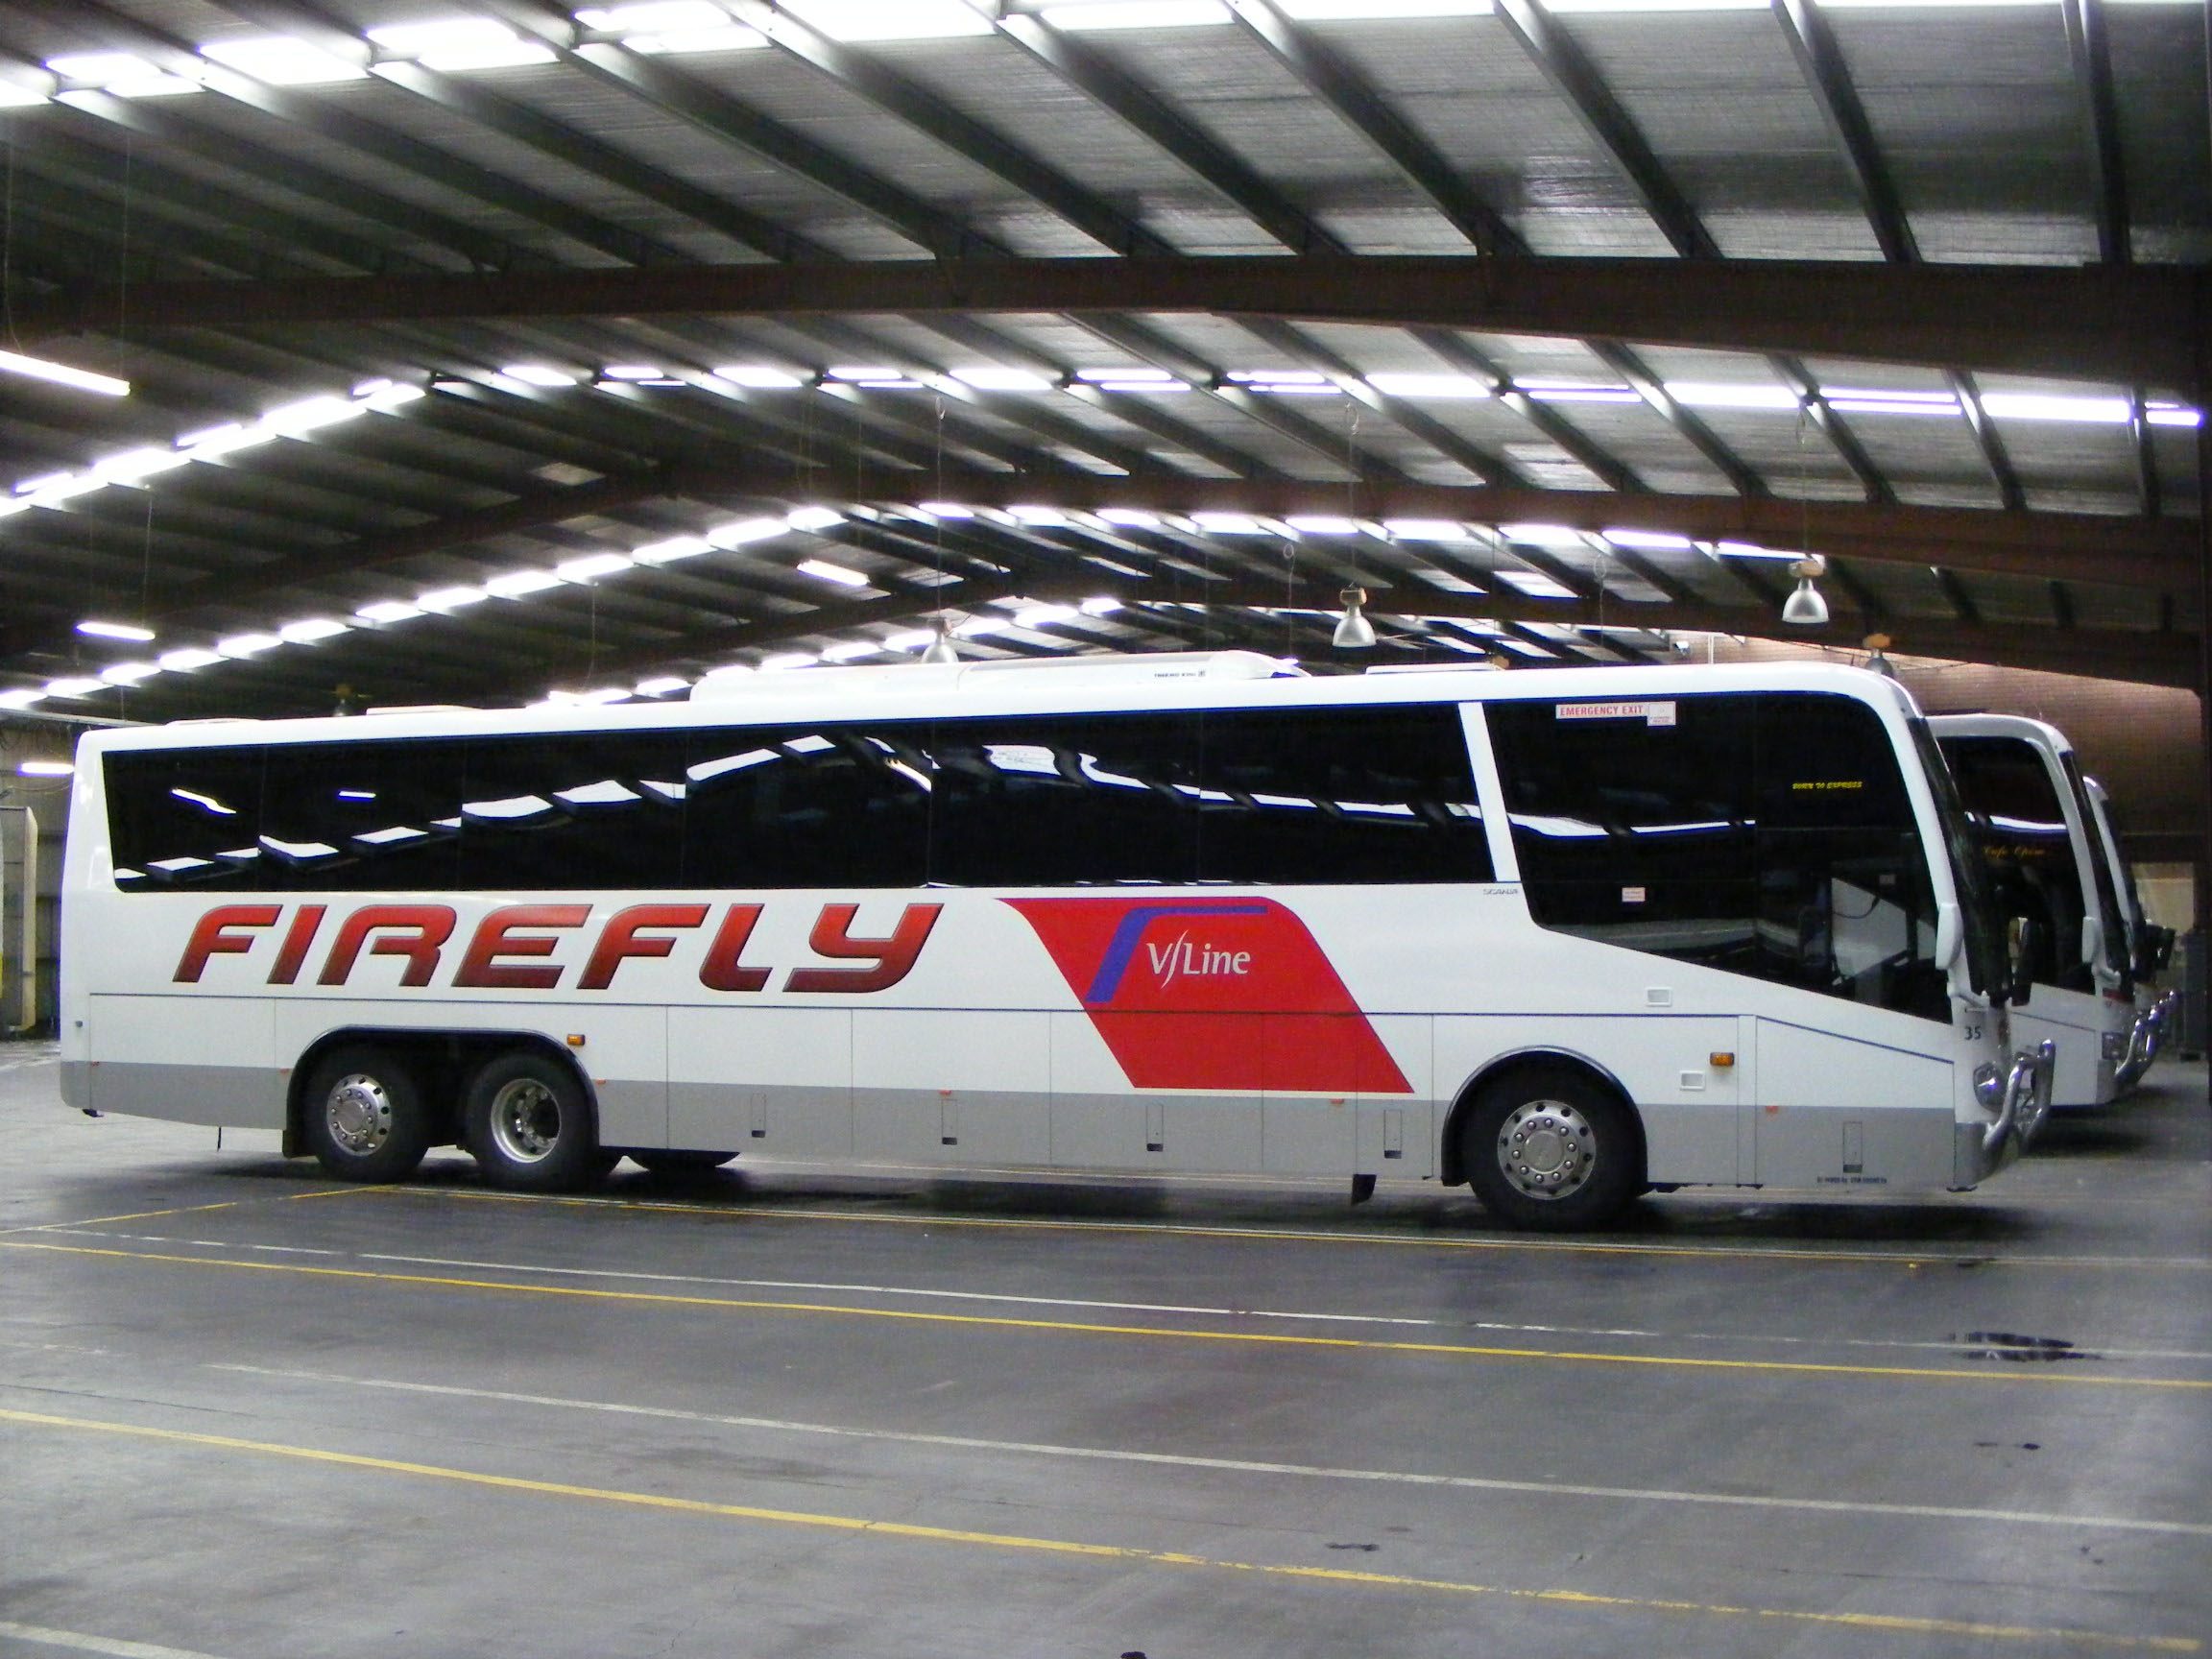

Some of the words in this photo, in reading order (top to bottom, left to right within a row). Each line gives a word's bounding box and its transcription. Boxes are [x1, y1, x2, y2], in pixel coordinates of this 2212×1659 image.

[1559, 706, 1619, 716] EMERGENCY
[1622, 705, 1644, 715] EXIT
[172, 902, 945, 993] FIREFLY
[1145, 929, 1251, 989] V/Line
[1964, 1025, 1982, 1041] 35
